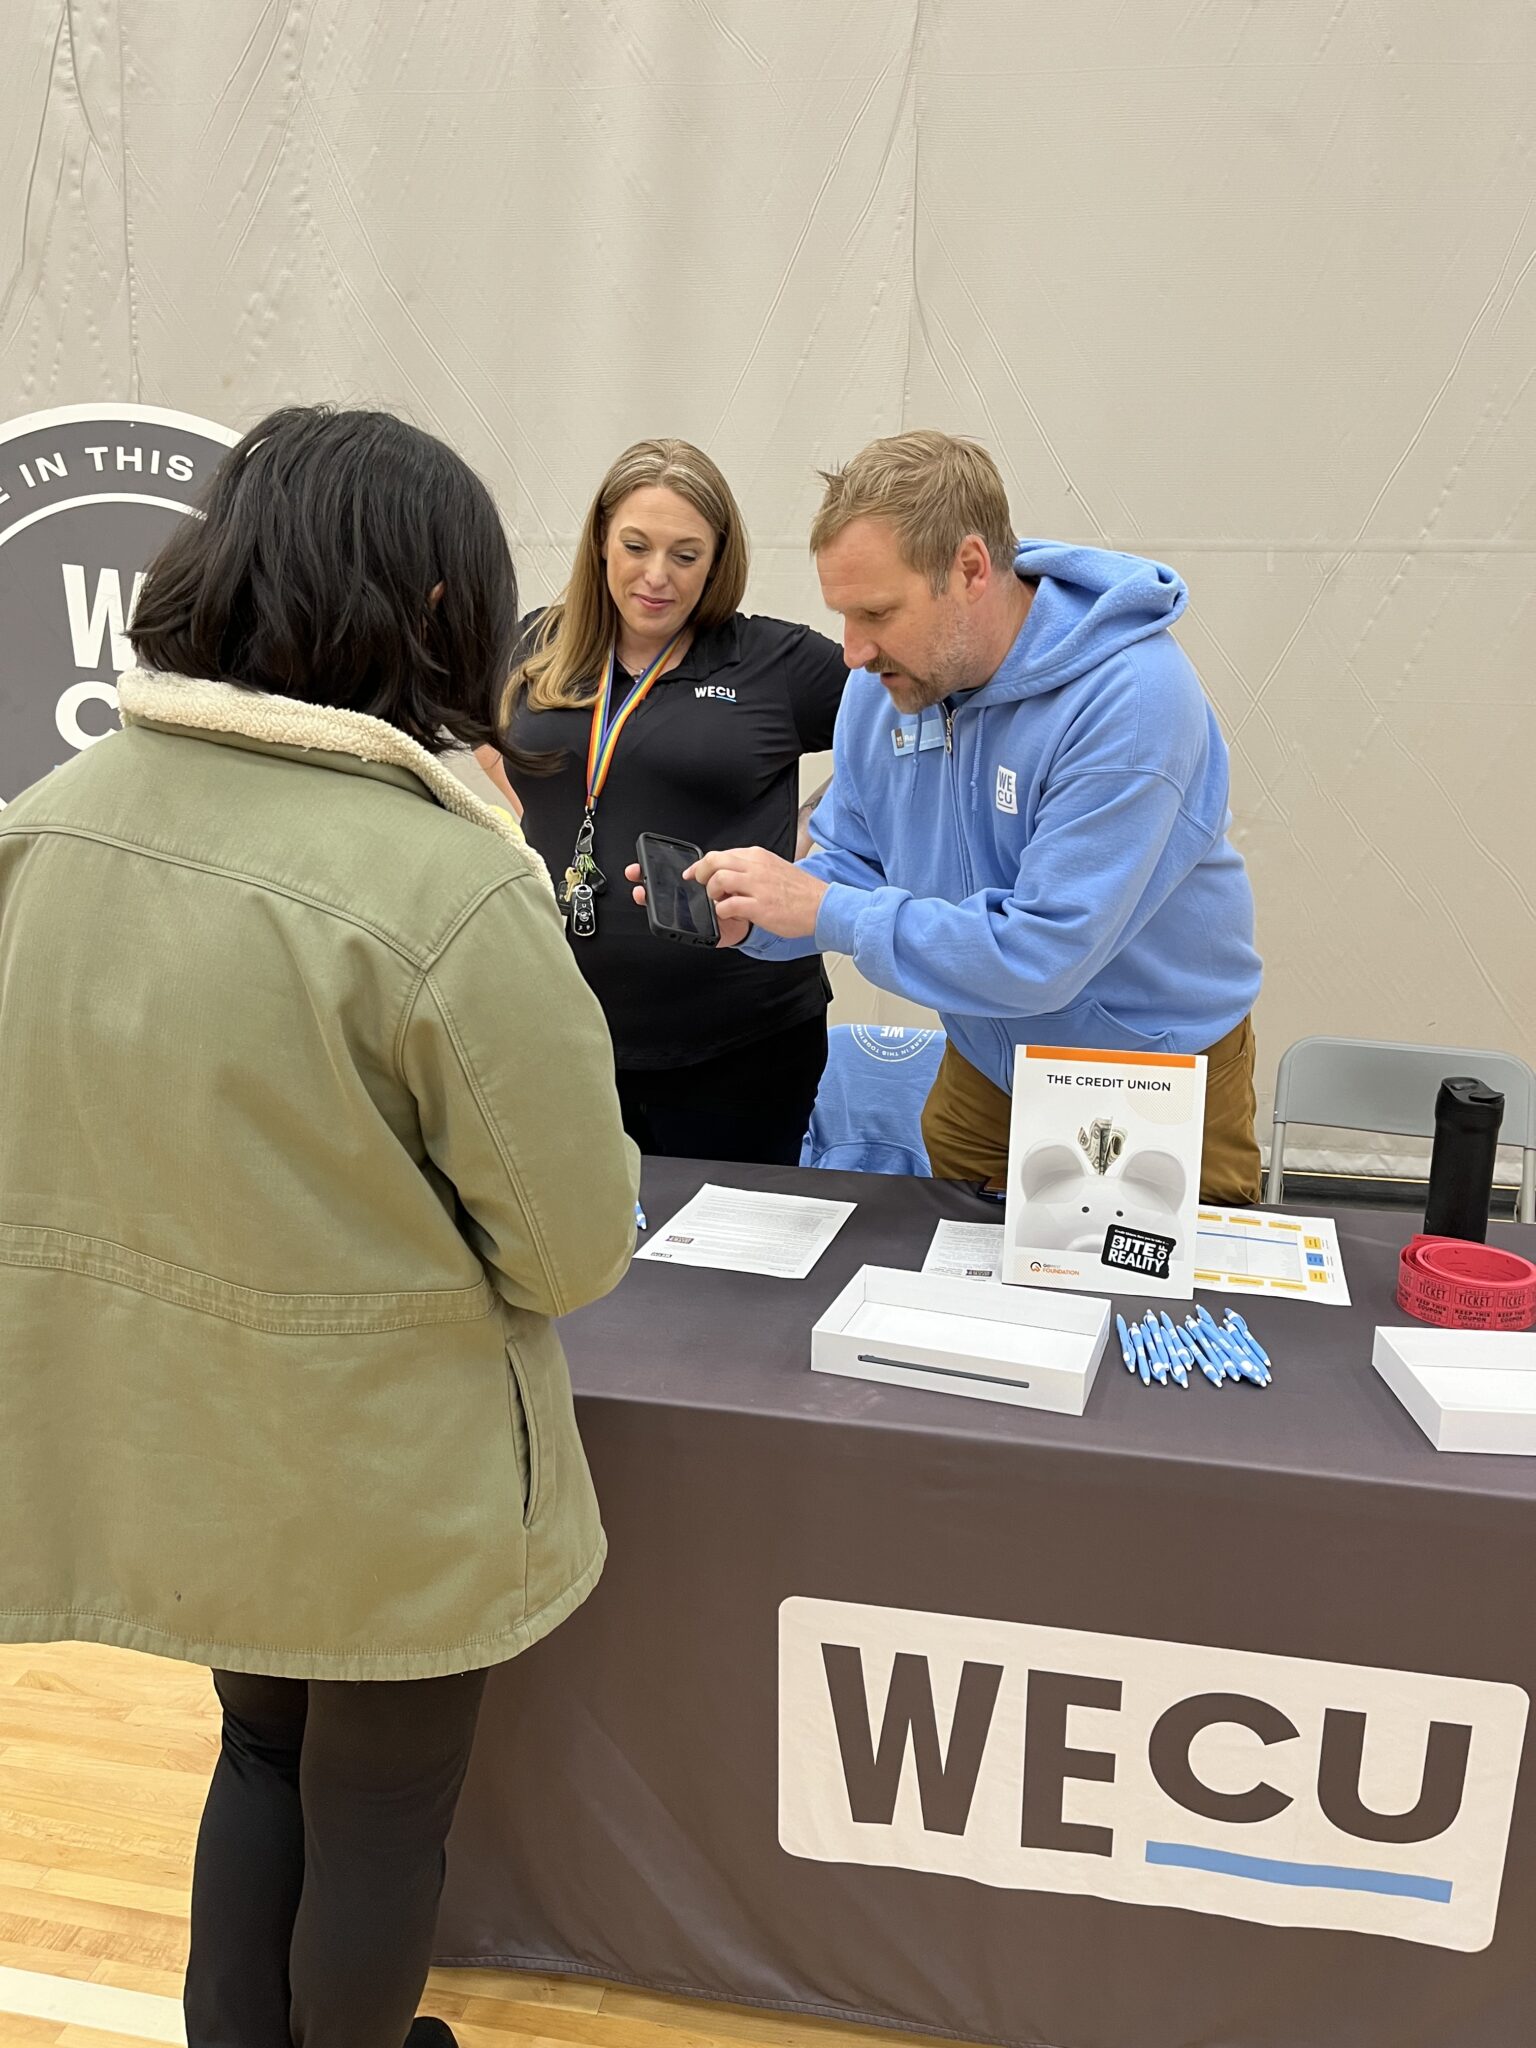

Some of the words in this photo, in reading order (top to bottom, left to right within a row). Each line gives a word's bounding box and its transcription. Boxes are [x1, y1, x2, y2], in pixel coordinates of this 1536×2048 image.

[18, 452, 69, 488] IN
[84, 446, 194, 482] THIS
[62, 563, 149, 672] W
[694, 685, 736, 699] WECU
[55, 681, 119, 752] C
[999, 770, 1013, 792] WE
[998, 790, 1013, 804] CU
[1047, 1074, 1072, 1085] THE
[1076, 1076, 1124, 1088] CREDIT
[1128, 1080, 1171, 1091] UNION
[1111, 1234, 1157, 1257] BITE
[1157, 1244, 1168, 1260] OF
[1108, 1248, 1165, 1273] REALITY
[1043, 1267, 1080, 1276] FOUNDATION
[1419, 1282, 1446, 1299] TICKET
[1458, 1294, 1491, 1306] TICKET
[1417, 1303, 1442, 1315] COUPON
[820, 1642, 1473, 1857] WECU
